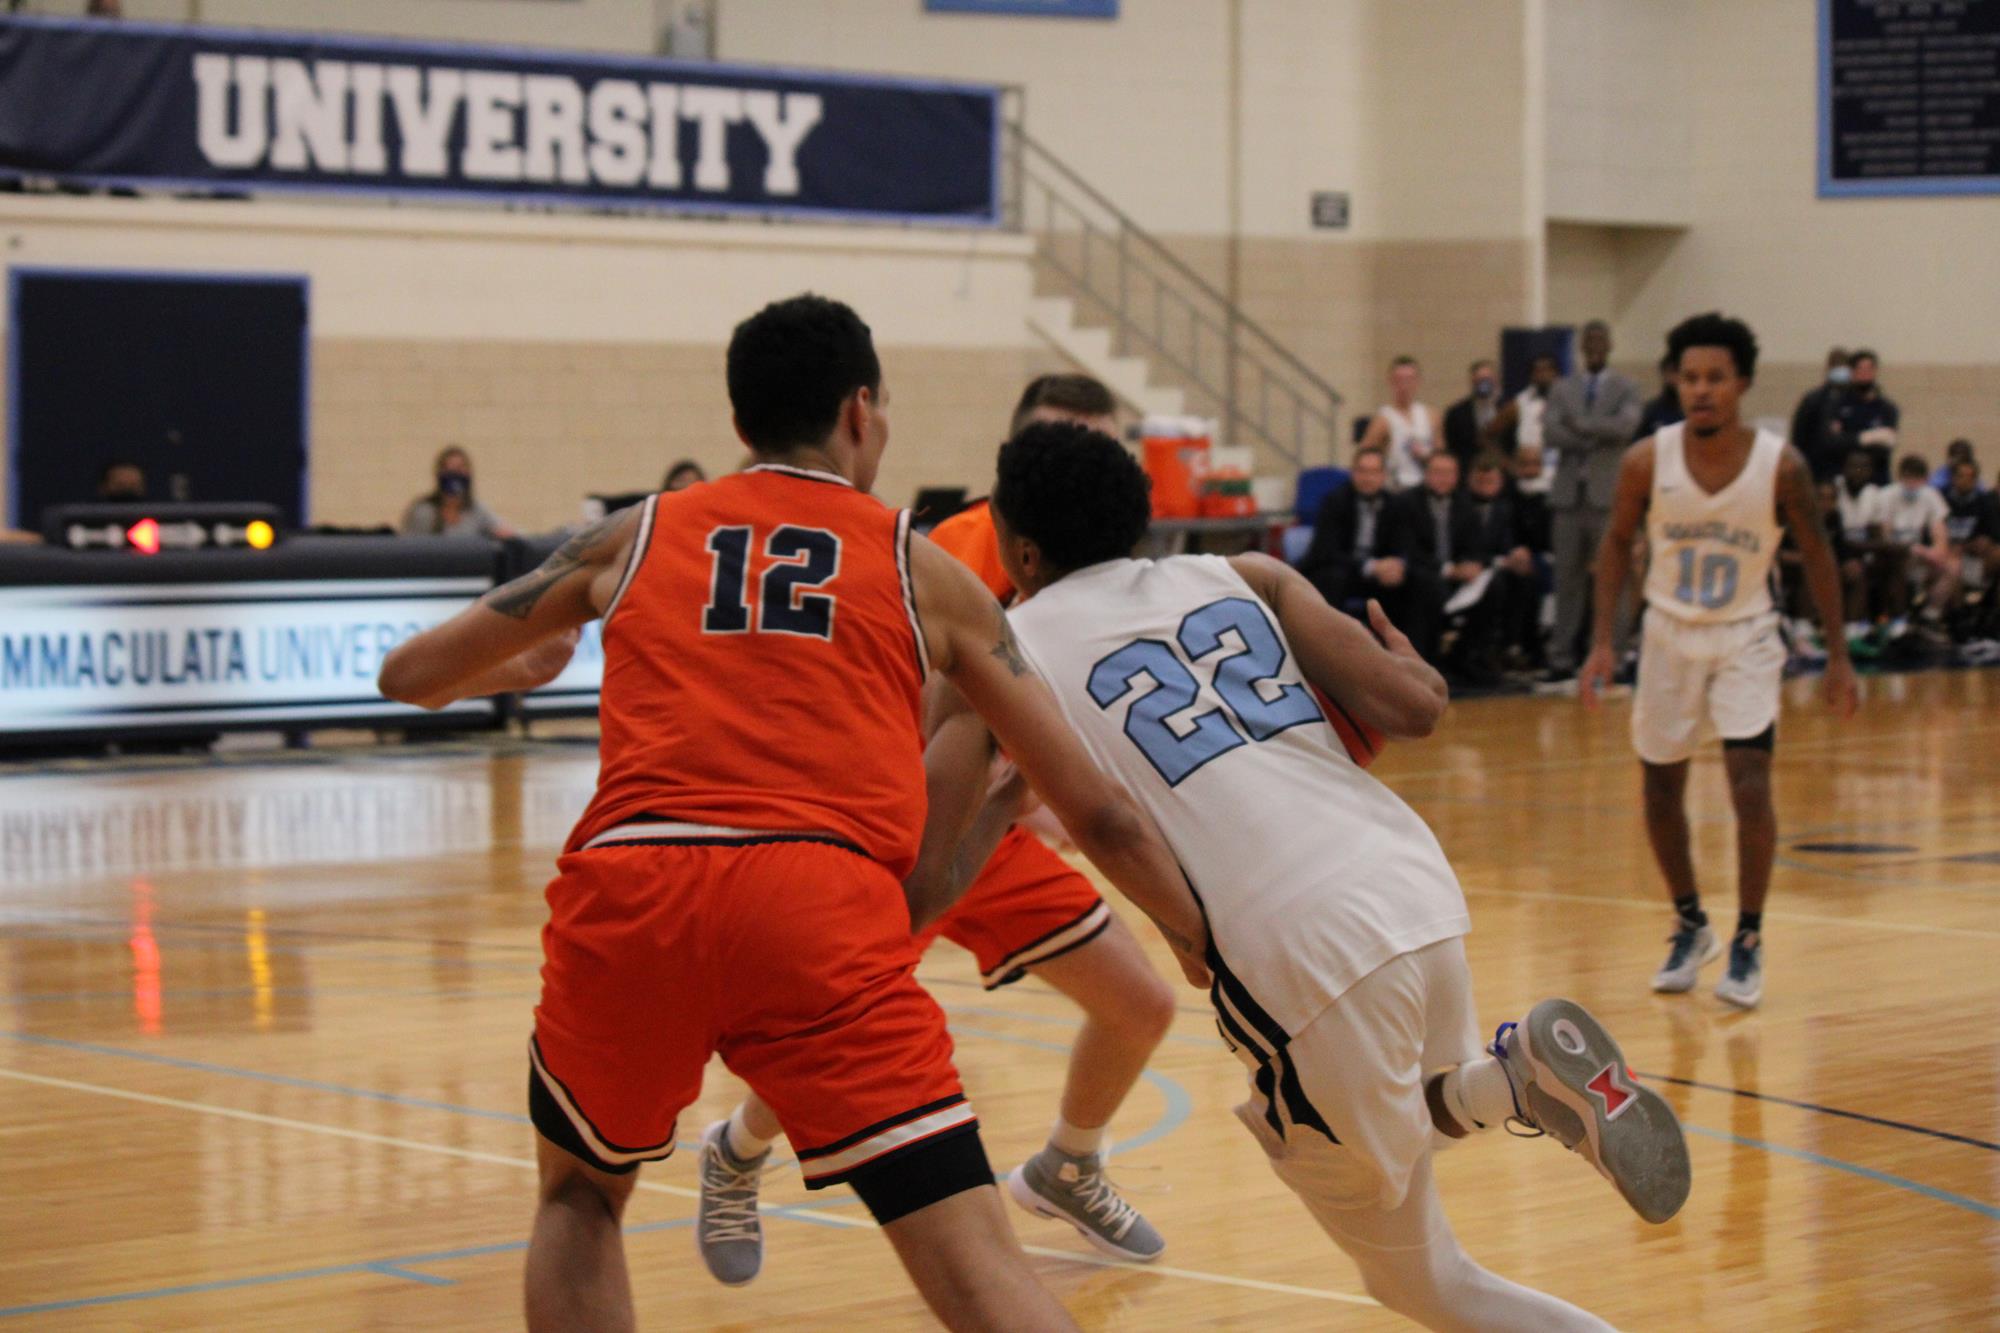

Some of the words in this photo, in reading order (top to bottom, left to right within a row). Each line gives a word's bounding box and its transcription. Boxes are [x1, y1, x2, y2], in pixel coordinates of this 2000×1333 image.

[193, 53, 823, 196] UNIVERSITY
[700, 524, 843, 641] 12
[1673, 547, 1740, 609] 10
[257, 620, 440, 682] UNIVER
[1086, 596, 1325, 788] 22
